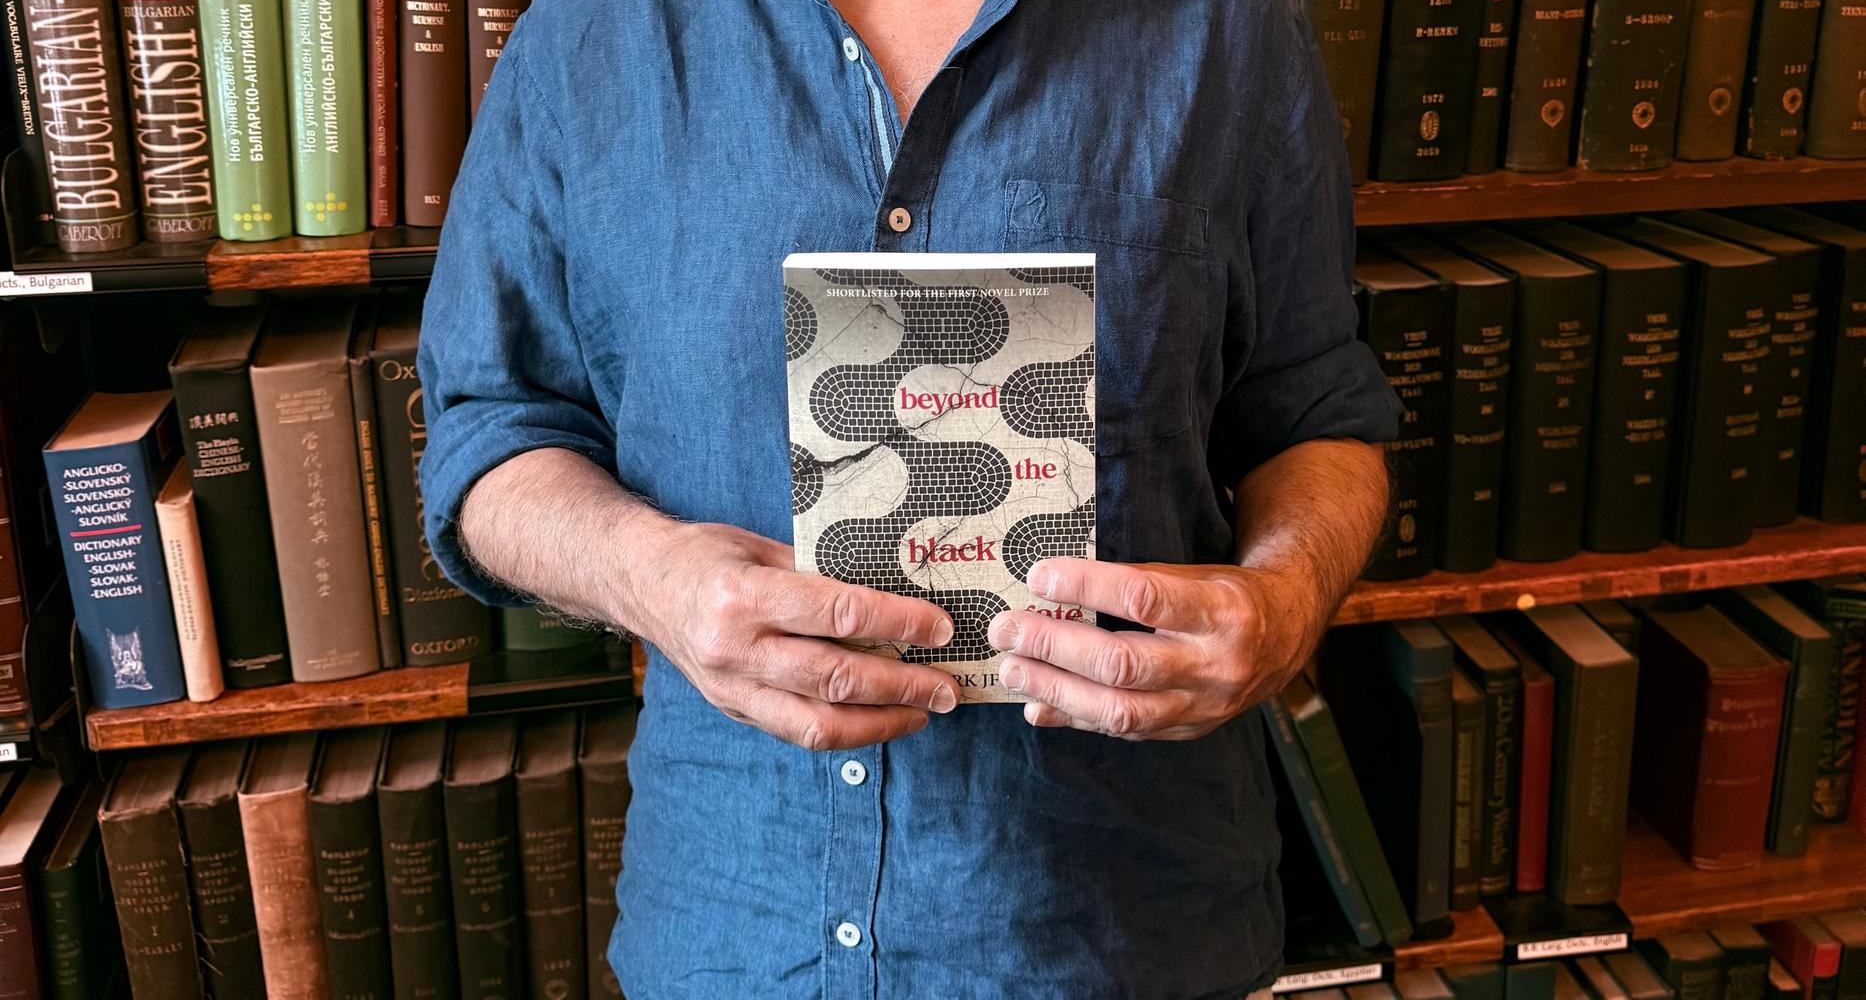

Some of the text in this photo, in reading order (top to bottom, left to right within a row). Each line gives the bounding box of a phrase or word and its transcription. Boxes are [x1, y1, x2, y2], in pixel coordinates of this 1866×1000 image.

[124, 5, 195, 17] BULGARIAN
[413, 16, 445, 25] BURMESE
[415, 43, 444, 52] ENGLISH
[6, 1, 34, 136] VOCABULAIRE VIEUX-BRETON
[300, 0, 318, 152] Нов универсален речник
[220, 8, 242, 162] Нов универсален речник
[239, 4, 264, 162] БЪЛГАРСКО-АНГЛИЙСКИ
[29, 6, 121, 212] BULGARIAN
[127, 27, 213, 207] ENGLISH
[59, 222, 124, 242] GABEROFF
[0, 277, 84, 289] cts., Bulgarian
[826, 287, 1050, 298] SHORTLISTED FOR THE FIRST NOVEL PRIZE
[900, 385, 999, 416] beyond
[63, 463, 127, 478] ANGLICKO-
[1014, 458, 1057, 480] the
[63, 474, 131, 490] -SLOVENSKÝ
[63, 487, 135, 503] SLOVENSKO-
[71, 499, 132, 514] -ANGLICKÝ
[78, 512, 128, 527] SLOVNÍK
[73, 535, 143, 552] DICTIONARY
[908, 535, 997, 564] black
[84, 550, 136, 563] ENGLISH-
[88, 561, 136, 574] -SLOVAK
[90, 575, 138, 586] SLOVAK-
[90, 585, 143, 598] -ENGLISH
